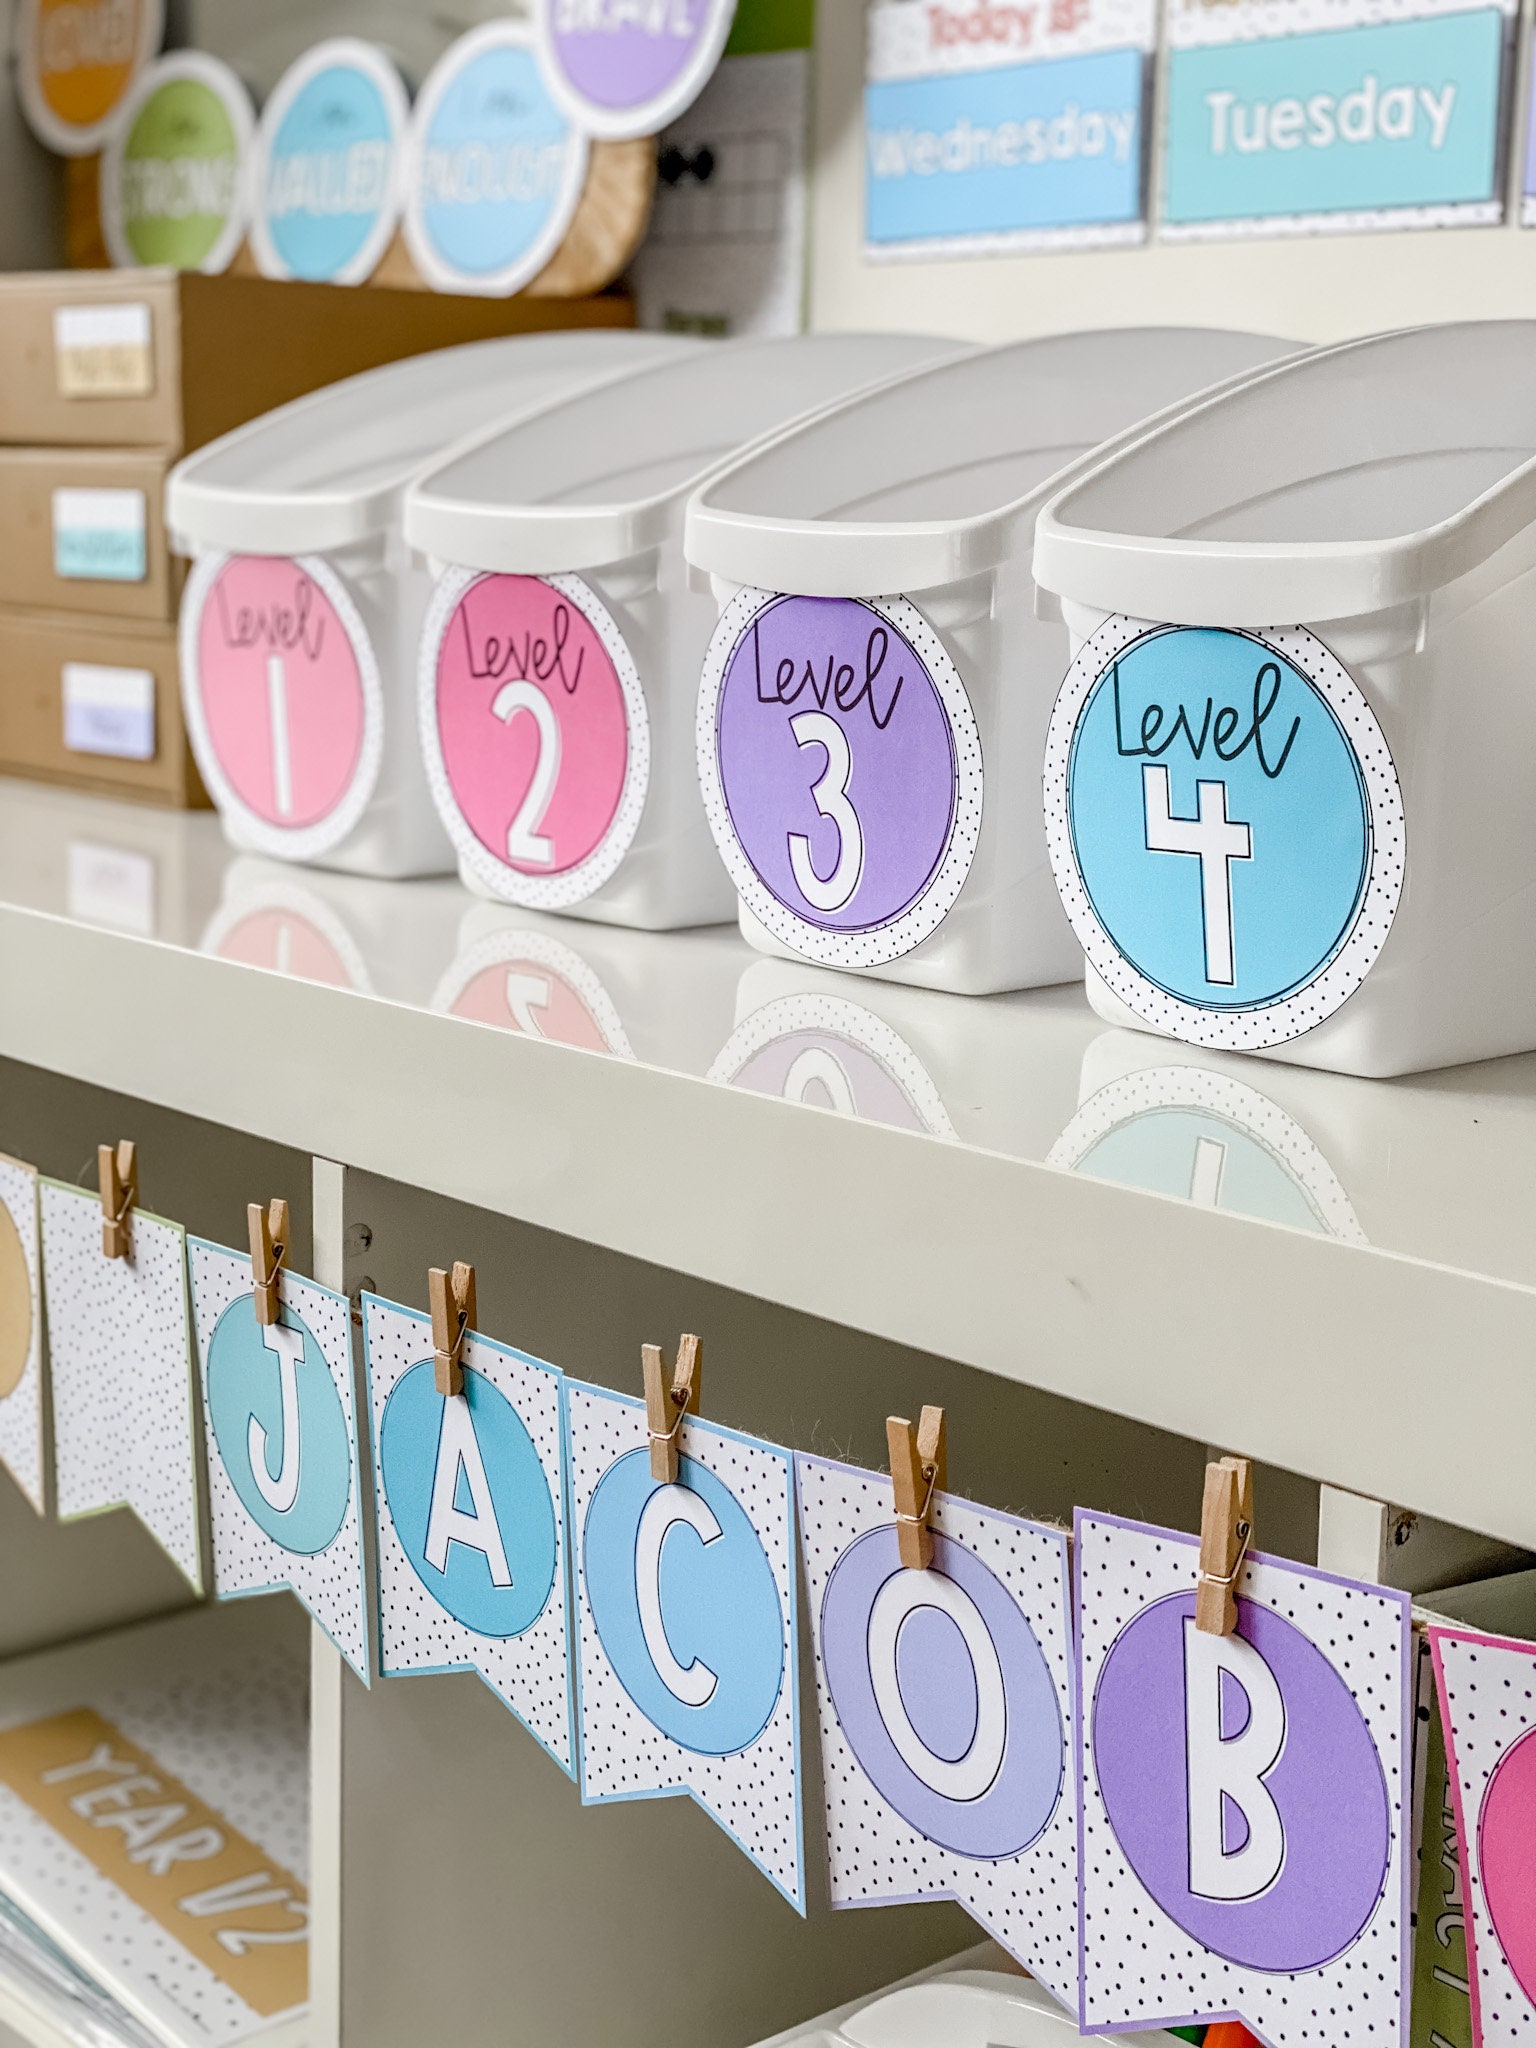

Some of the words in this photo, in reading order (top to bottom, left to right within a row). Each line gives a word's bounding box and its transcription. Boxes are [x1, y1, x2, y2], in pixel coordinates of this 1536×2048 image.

[867, 100, 1137, 177] Wednesday
[1206, 74, 1456, 155] Tuesday
[216, 579, 325, 661] Level
[460, 600, 584, 693] Level
[754, 618, 903, 730] Level
[264, 652, 294, 818] 1
[492, 677, 561, 867] 2
[1113, 661, 1300, 778] Level
[787, 709, 865, 914] 3
[1141, 762, 1254, 989] 4
[40, 1742, 225, 1878] YEAR
